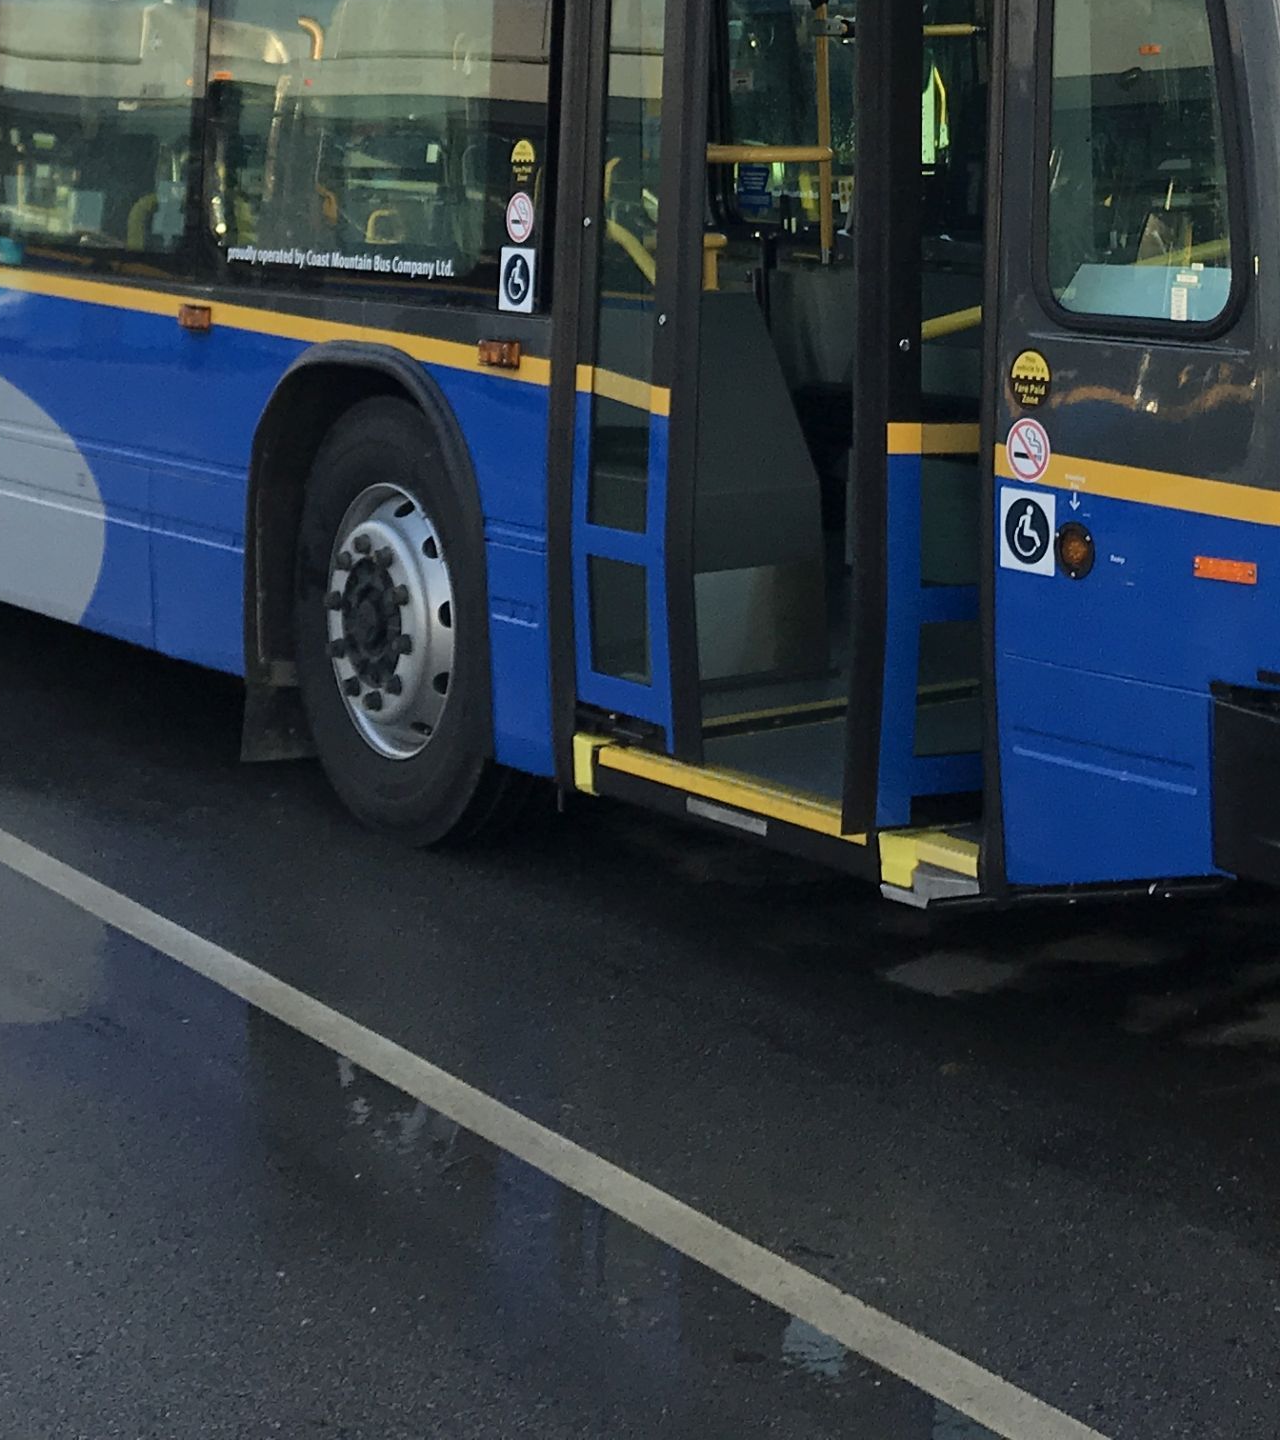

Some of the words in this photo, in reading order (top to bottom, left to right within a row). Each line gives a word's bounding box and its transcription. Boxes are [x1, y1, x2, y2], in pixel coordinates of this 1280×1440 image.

[227, 245, 257, 265] proudly
[258, 248, 294, 266] operated
[295, 249, 305, 269] by
[306, 250, 330, 267] Coast
[331, 252, 372, 270] Mountain
[373, 255, 391, 272] Bus
[392, 256, 434, 279] Company
[436, 259, 455, 277] Ltd.
[1014, 382, 1029, 394] Fare
[1030, 383, 1046, 396] Paid
